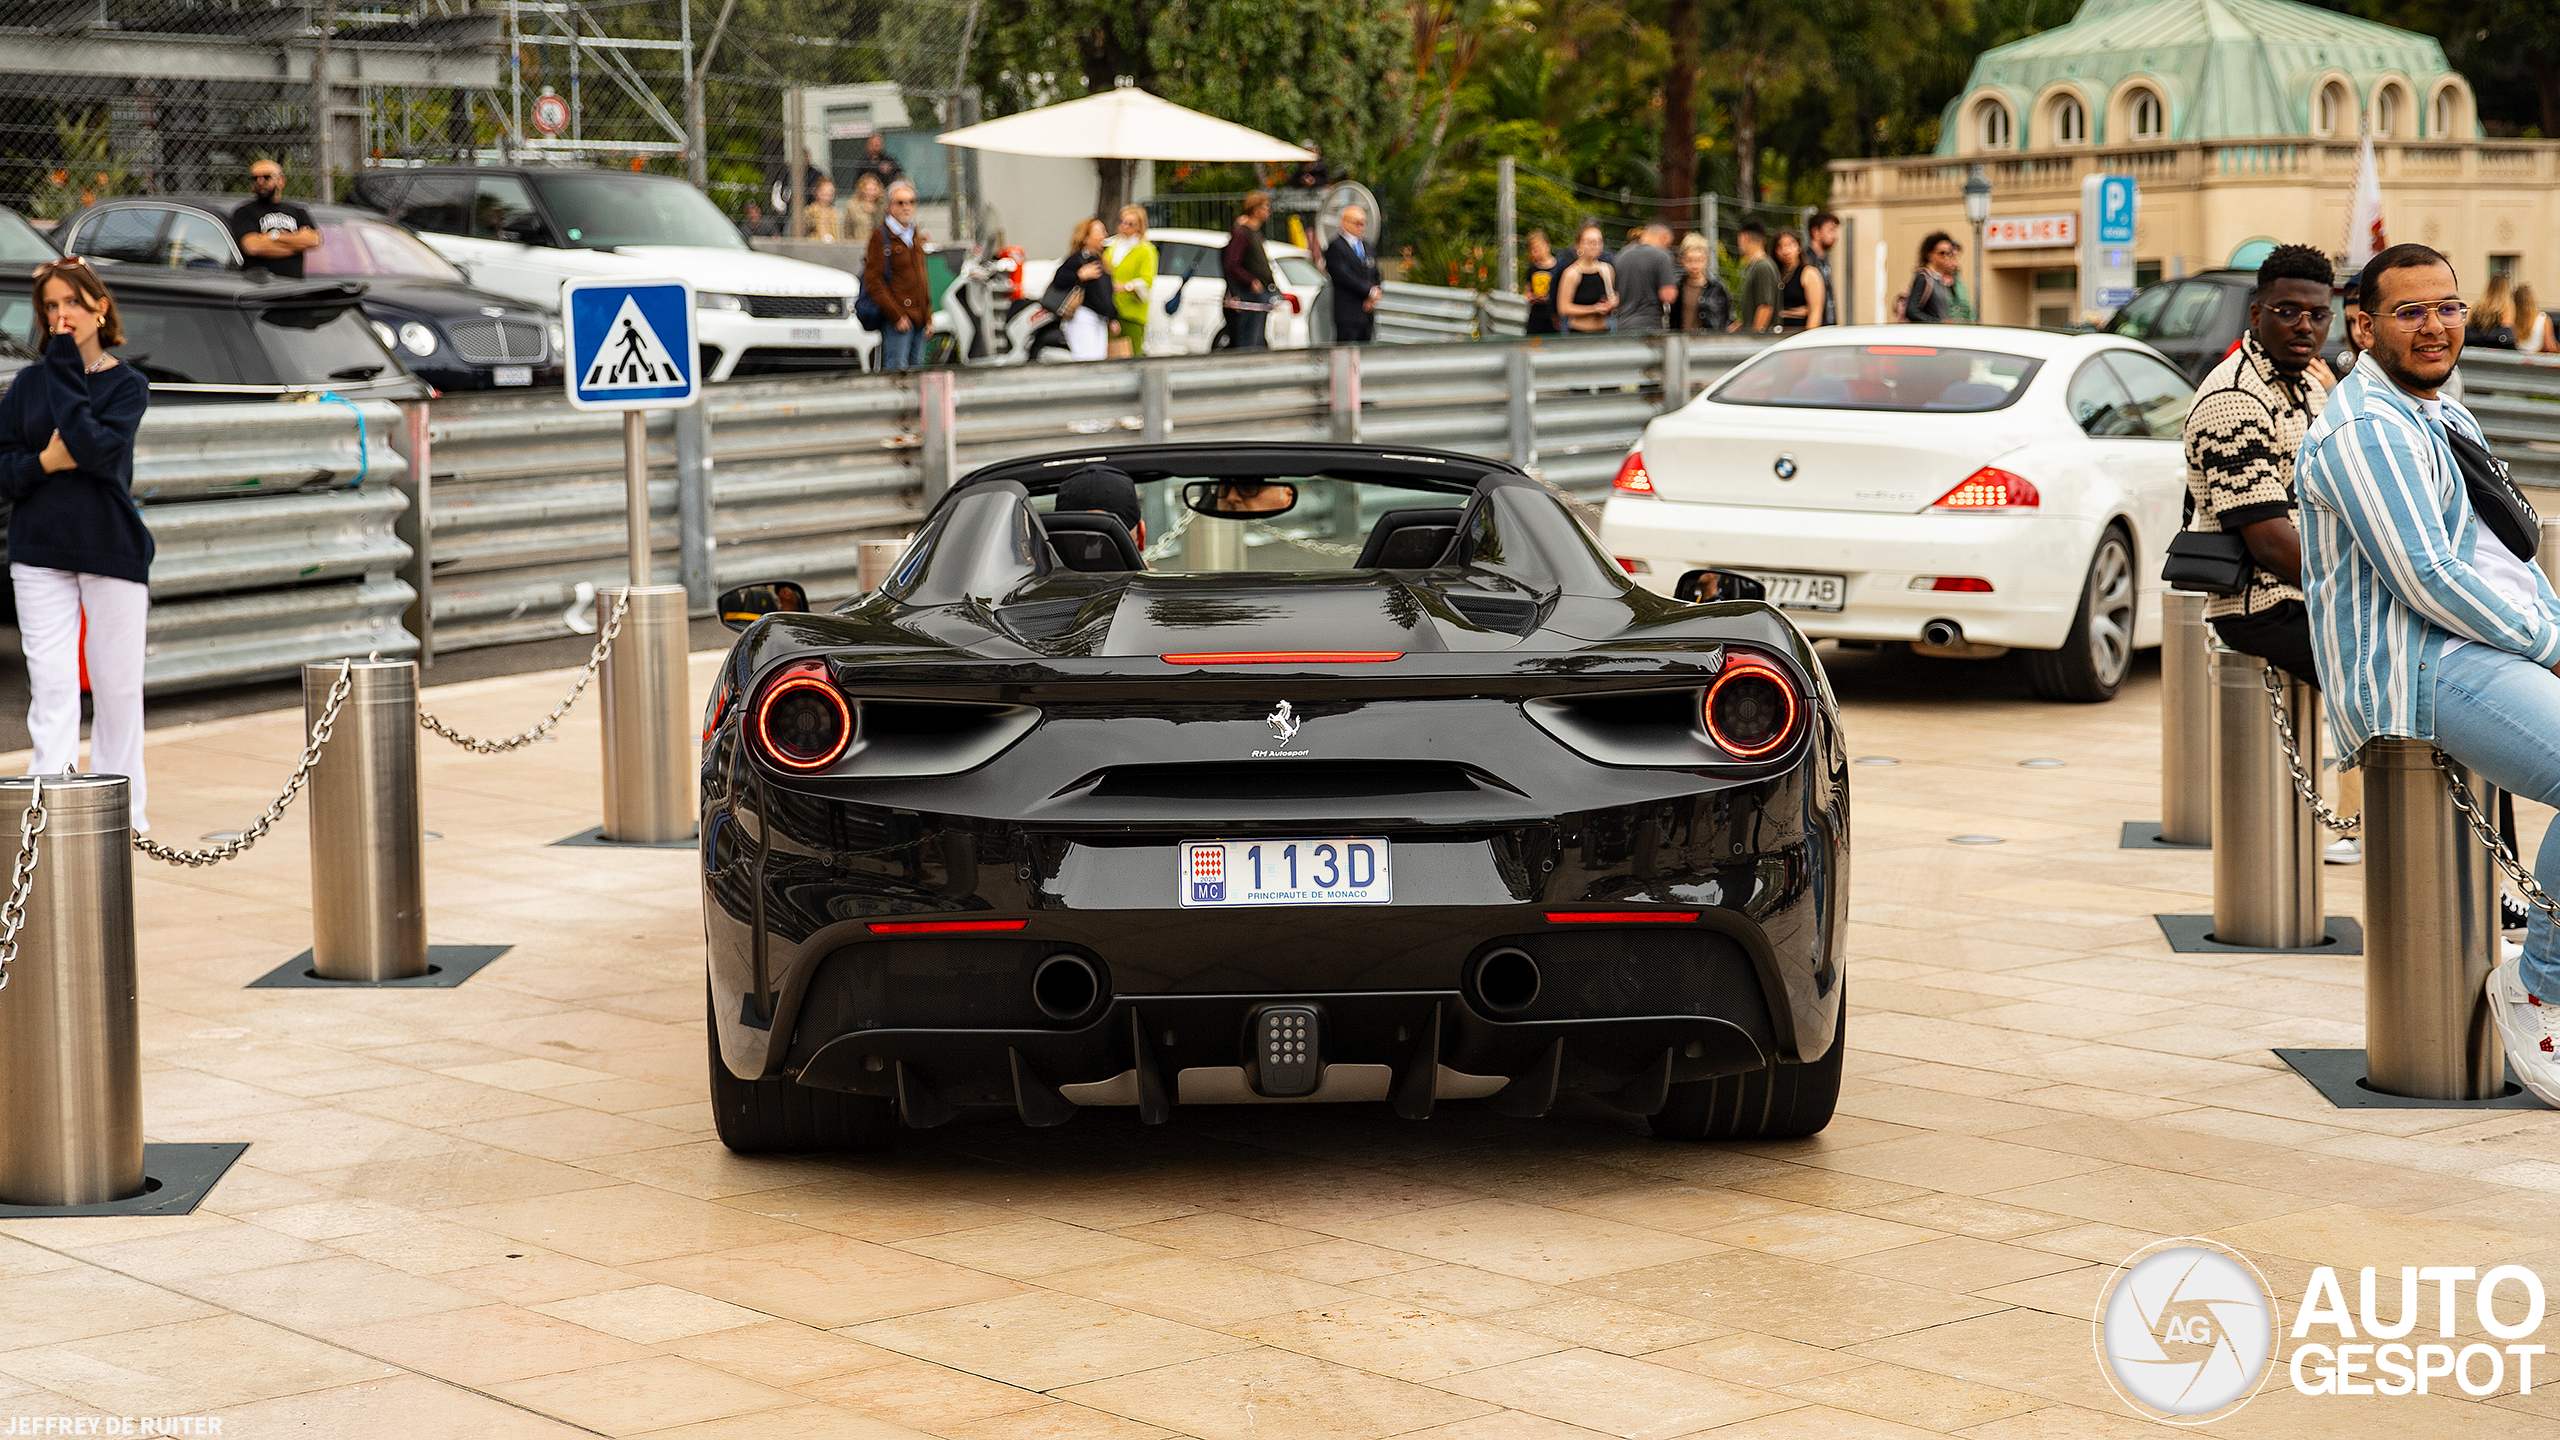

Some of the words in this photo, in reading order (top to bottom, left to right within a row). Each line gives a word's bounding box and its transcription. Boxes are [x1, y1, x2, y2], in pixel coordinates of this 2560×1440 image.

[2106, 182, 2126, 222] P
[1987, 219, 2069, 242] POLICE
[1806, 579, 1836, 601] AB
[1269, 749, 1309, 757] Autosport
[1248, 844, 1375, 889] 113D
[1199, 884, 1218, 899] MC
[1247, 891, 1307, 900] PRINCIPAUTE
[1327, 890, 1367, 898] MONACO
